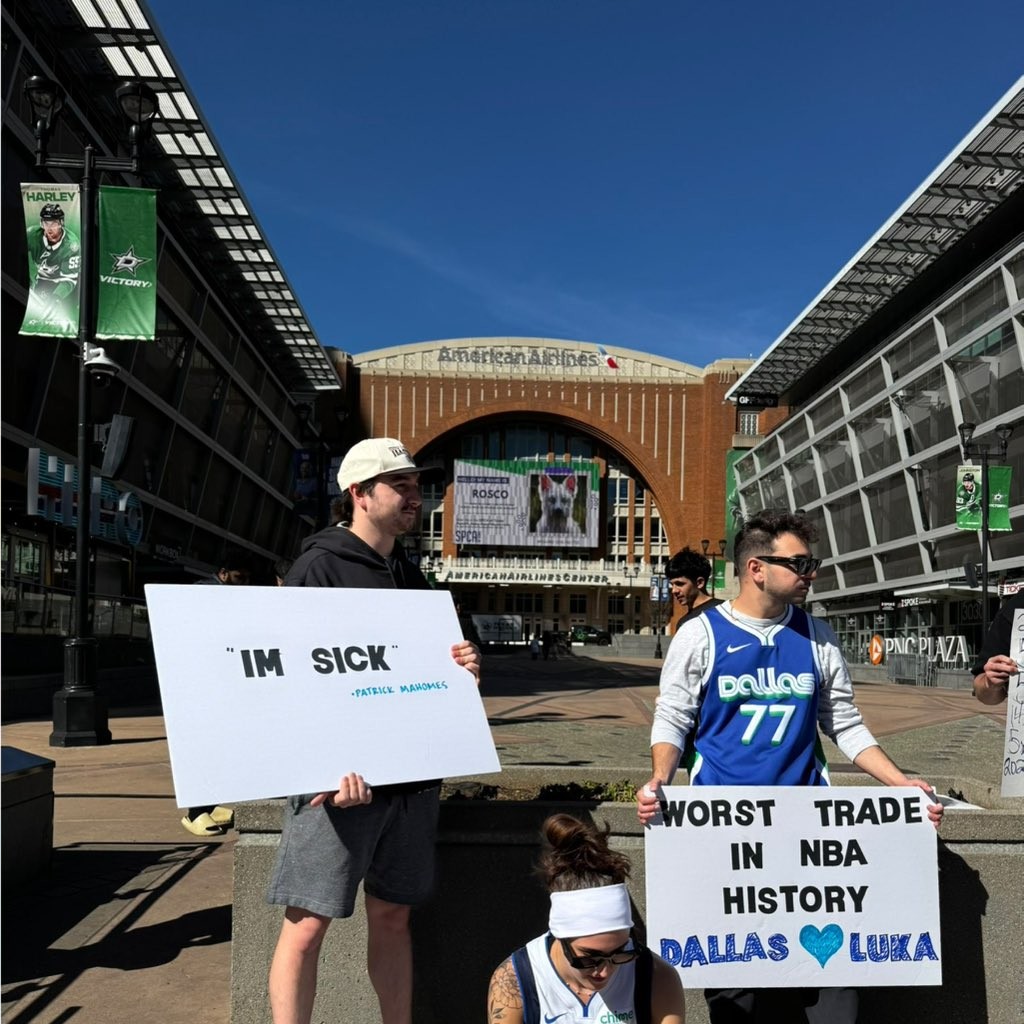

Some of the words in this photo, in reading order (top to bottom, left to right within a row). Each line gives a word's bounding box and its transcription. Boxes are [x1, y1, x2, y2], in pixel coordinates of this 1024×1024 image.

[26, 192, 75, 202] HARLEY
[99, 274, 149, 288] VICTORY
[438, 346, 525, 365] American
[528, 349, 599, 367] Airlines
[472, 489, 509, 500] ROSCO
[885, 638, 914, 660] PNC
[919, 636, 969, 662] PLAZA
[400, 681, 448, 693] MAHOMES
[739, 704, 797, 746] 77
[662, 799, 775, 828] WORST
[815, 796, 922, 827] TRADE
[730, 842, 764, 870] IN
[800, 839, 868, 867] NBA
[723, 885, 869, 915] HISTORY
[660, 932, 789, 968] DALLAS
[850, 932, 939, 962] LUKA
[600, 1010, 634, 1024] chime
